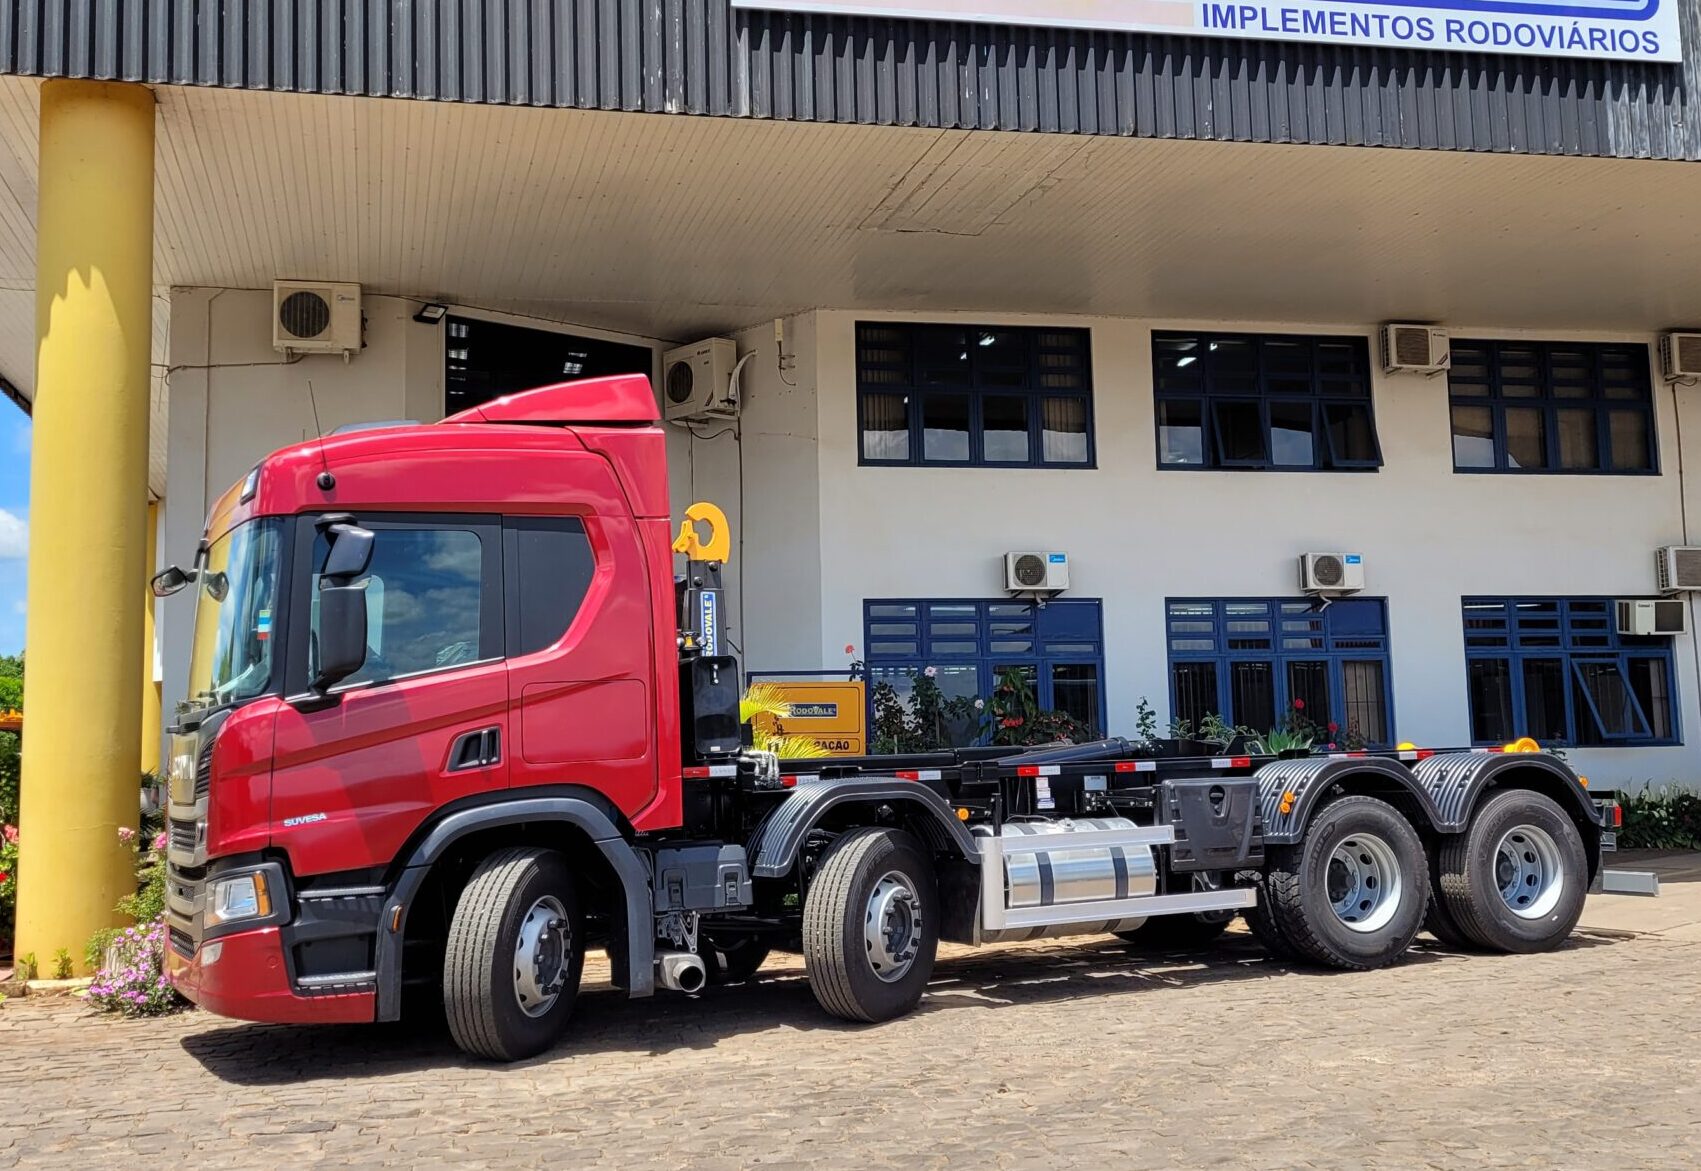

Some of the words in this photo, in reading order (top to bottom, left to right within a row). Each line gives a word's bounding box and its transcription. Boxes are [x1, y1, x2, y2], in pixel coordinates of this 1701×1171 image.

[1202, 3, 1434, 42] IMPLEMENTOS
[1445, 18, 1660, 54] RODOVIÁRIOS
[283, 812, 328, 827] SUVESA
